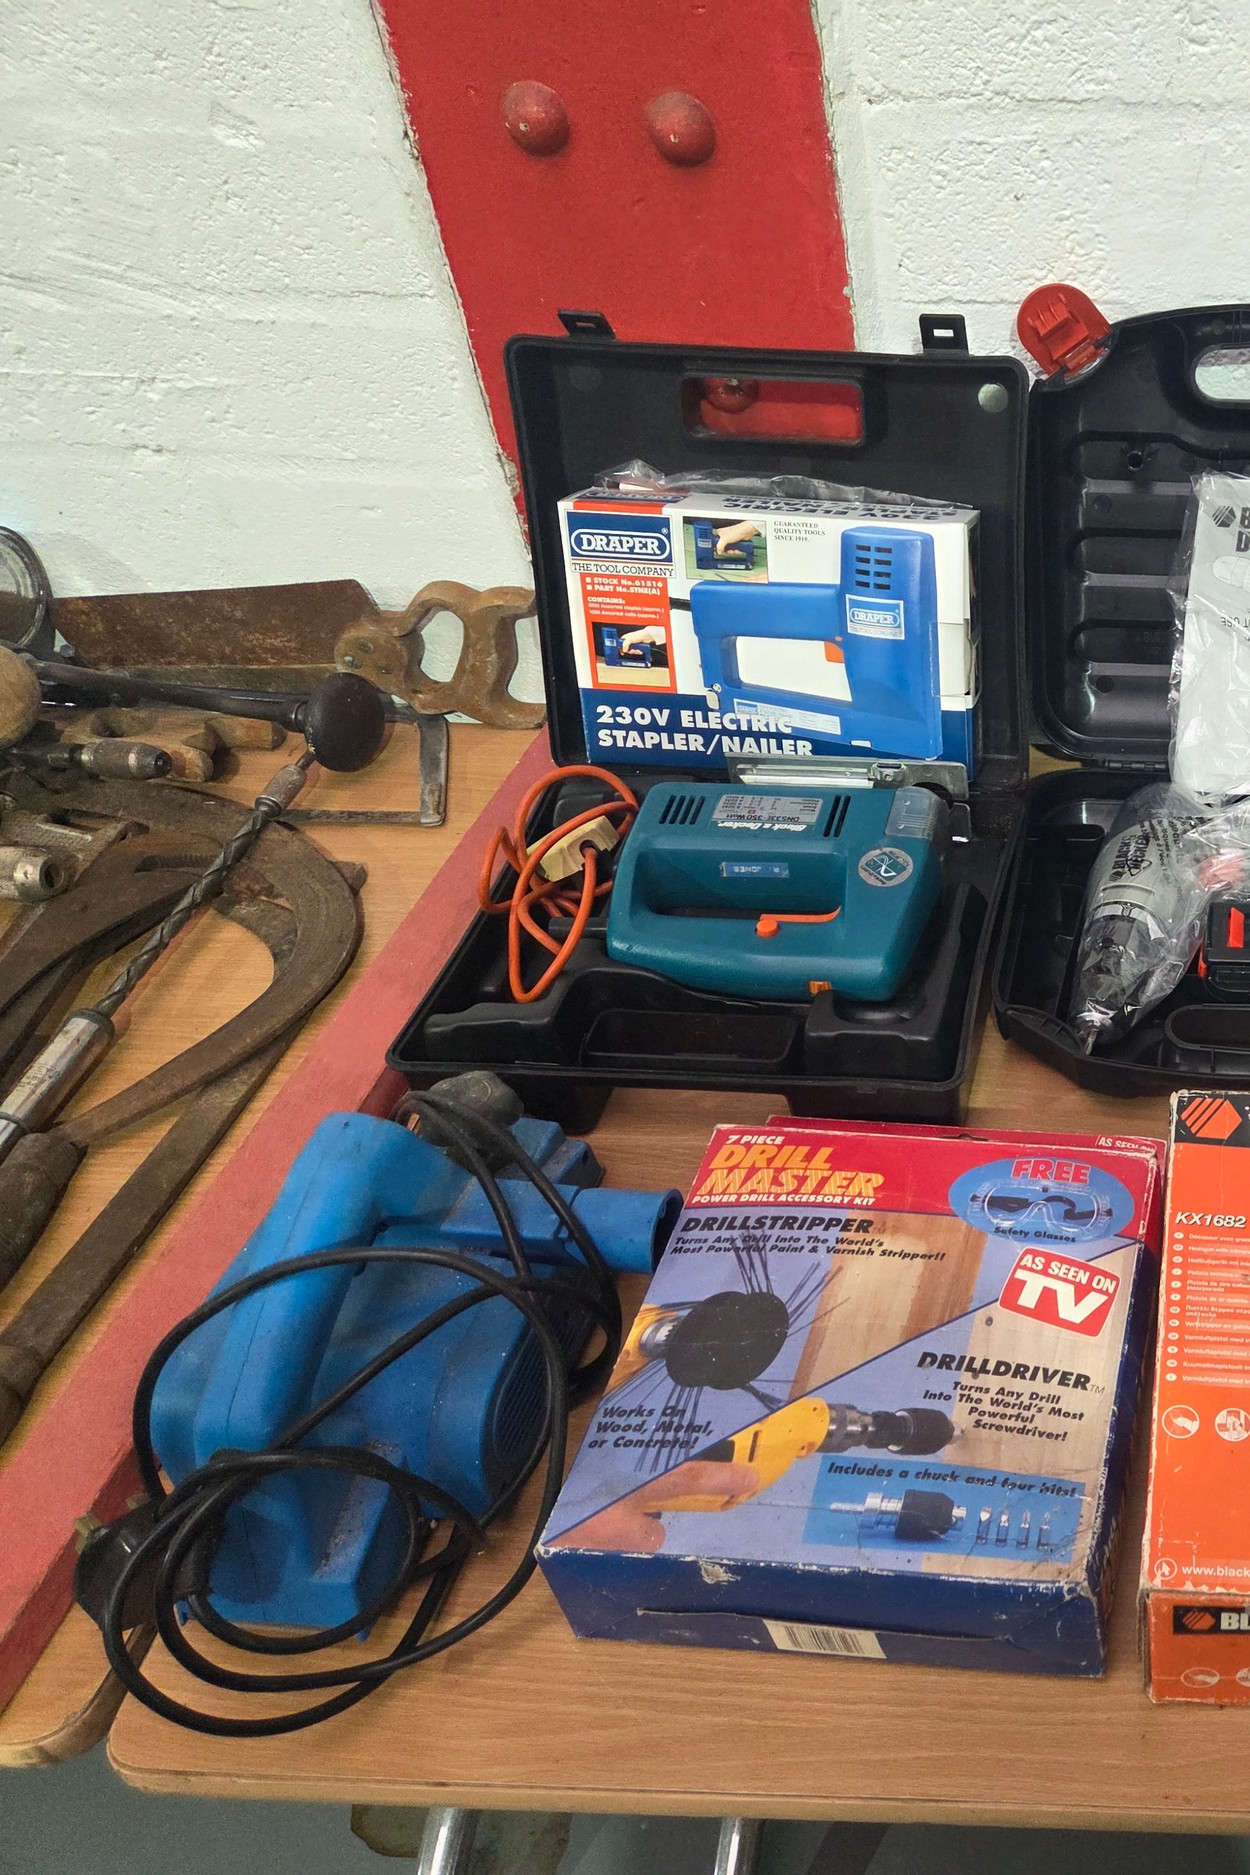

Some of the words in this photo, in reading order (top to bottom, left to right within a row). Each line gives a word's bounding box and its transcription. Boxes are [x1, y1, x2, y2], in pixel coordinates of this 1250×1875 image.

[773, 520, 819, 529] GUARANTEED
[773, 527, 804, 535] QUALITY
[580, 534, 661, 554] DRAPER
[571, 563, 592, 572] THE
[594, 564, 621, 573] TOOL
[622, 565, 674, 577] COMPANY
[593, 577, 619, 585] STOCK
[853, 610, 895, 624] DRAPER
[596, 705, 671, 727] 230V
[680, 709, 793, 734] ELECTRIC
[598, 729, 813, 756] STAPLER/NAILER
[726, 1135, 737, 1145] 7
[740, 1135, 785, 1145] PIECE
[1098, 1136, 1112, 1147] AS
[709, 1144, 834, 1170] DRILL
[1010, 1158, 1091, 1184] FREE
[697, 1168, 885, 1197] MASTER
[692, 1194, 737, 1204] POWER
[740, 1194, 775, 1203] DRILL
[777, 1194, 852, 1204] ACCESSORY
[853, 1197, 876, 1206] KIT
[681, 1215, 875, 1234] DRILLSTRIPPER
[1174, 1211, 1247, 1229] KX1682
[675, 1236, 710, 1245] Turns
[712, 1236, 738, 1247] Any
[774, 1236, 801, 1244] Into
[806, 1236, 829, 1245] The
[835, 1237, 884, 1248] World's
[993, 1226, 1031, 1238] Safety
[1034, 1230, 1076, 1243] Glasses
[670, 1246, 704, 1255] Most
[769, 1244, 804, 1254] Paint
[810, 1245, 820, 1254] &
[826, 1245, 875, 1257] Varnish
[879, 1249, 946, 1262] Stripper!!
[1019, 1253, 1046, 1271] AS
[1047, 1261, 1090, 1285] SEEN
[1092, 1276, 1117, 1293] ON
[1013, 1268, 1109, 1325] TV
[916, 1351, 1092, 1392] DRILLDRIVER
[953, 1381, 991, 1395] Turns
[995, 1387, 1024, 1400] Any
[1029, 1391, 1061, 1405] Drill
[602, 1405, 656, 1418] Works
[922, 1390, 952, 1402] Into
[958, 1393, 983, 1405] The
[990, 1397, 1044, 1413] World's
[1048, 1407, 1085, 1421] Most
[968, 1406, 1036, 1423] Powerful
[595, 1420, 649, 1434] Wood,
[655, 1420, 714, 1436] Metal,
[972, 1419, 1068, 1442] Screwdriver!
[588, 1440, 608, 1449] or
[613, 1436, 699, 1449] Concrete!
[827, 1461, 893, 1478] Includes
[898, 1470, 908, 1478] a
[914, 1468, 960, 1483] chuck
[964, 1474, 997, 1487] and
